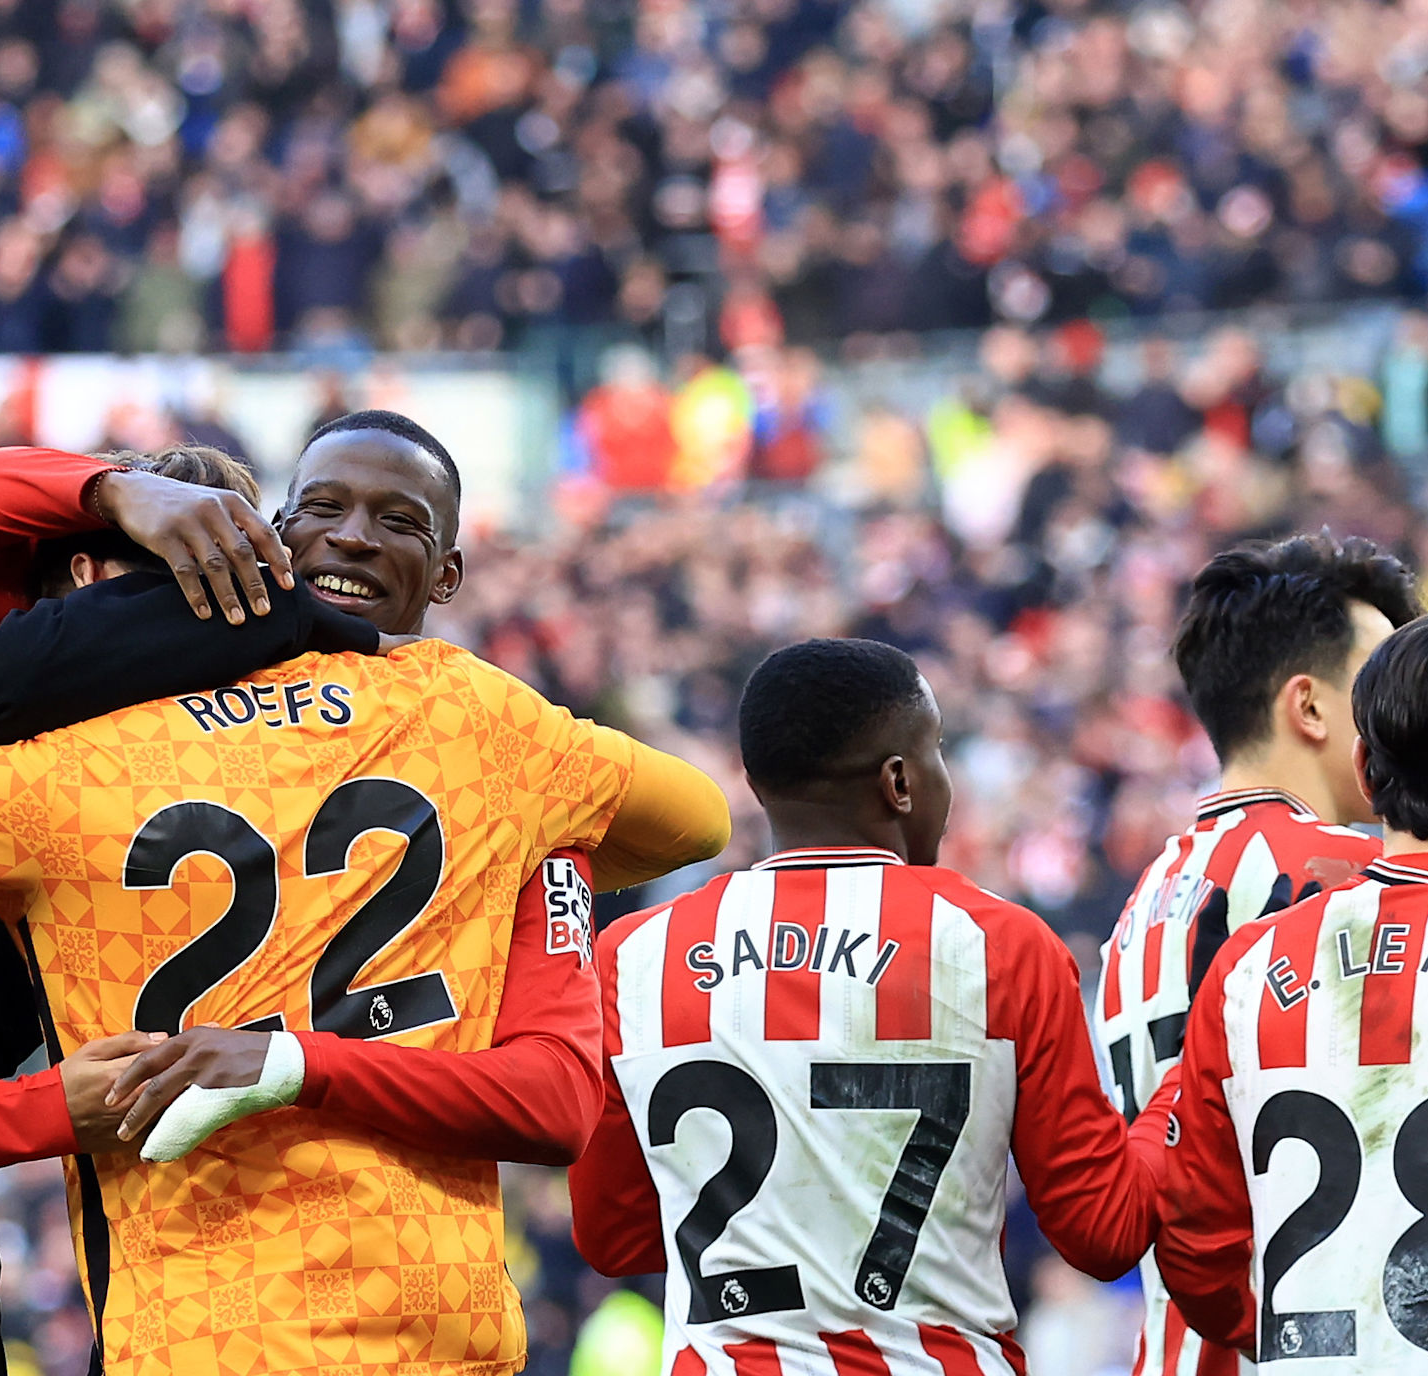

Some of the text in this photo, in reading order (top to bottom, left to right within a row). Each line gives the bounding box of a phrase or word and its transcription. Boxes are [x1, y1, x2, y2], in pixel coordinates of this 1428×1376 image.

[176, 681, 352, 732] ROEFS
[122, 777, 461, 1042] 22
[546, 861, 591, 911] Live
[686, 922, 899, 992] SADIKI
[1266, 955, 1322, 1011] E.
[1335, 923, 1410, 982] LE
[648, 1060, 971, 1325] 27
